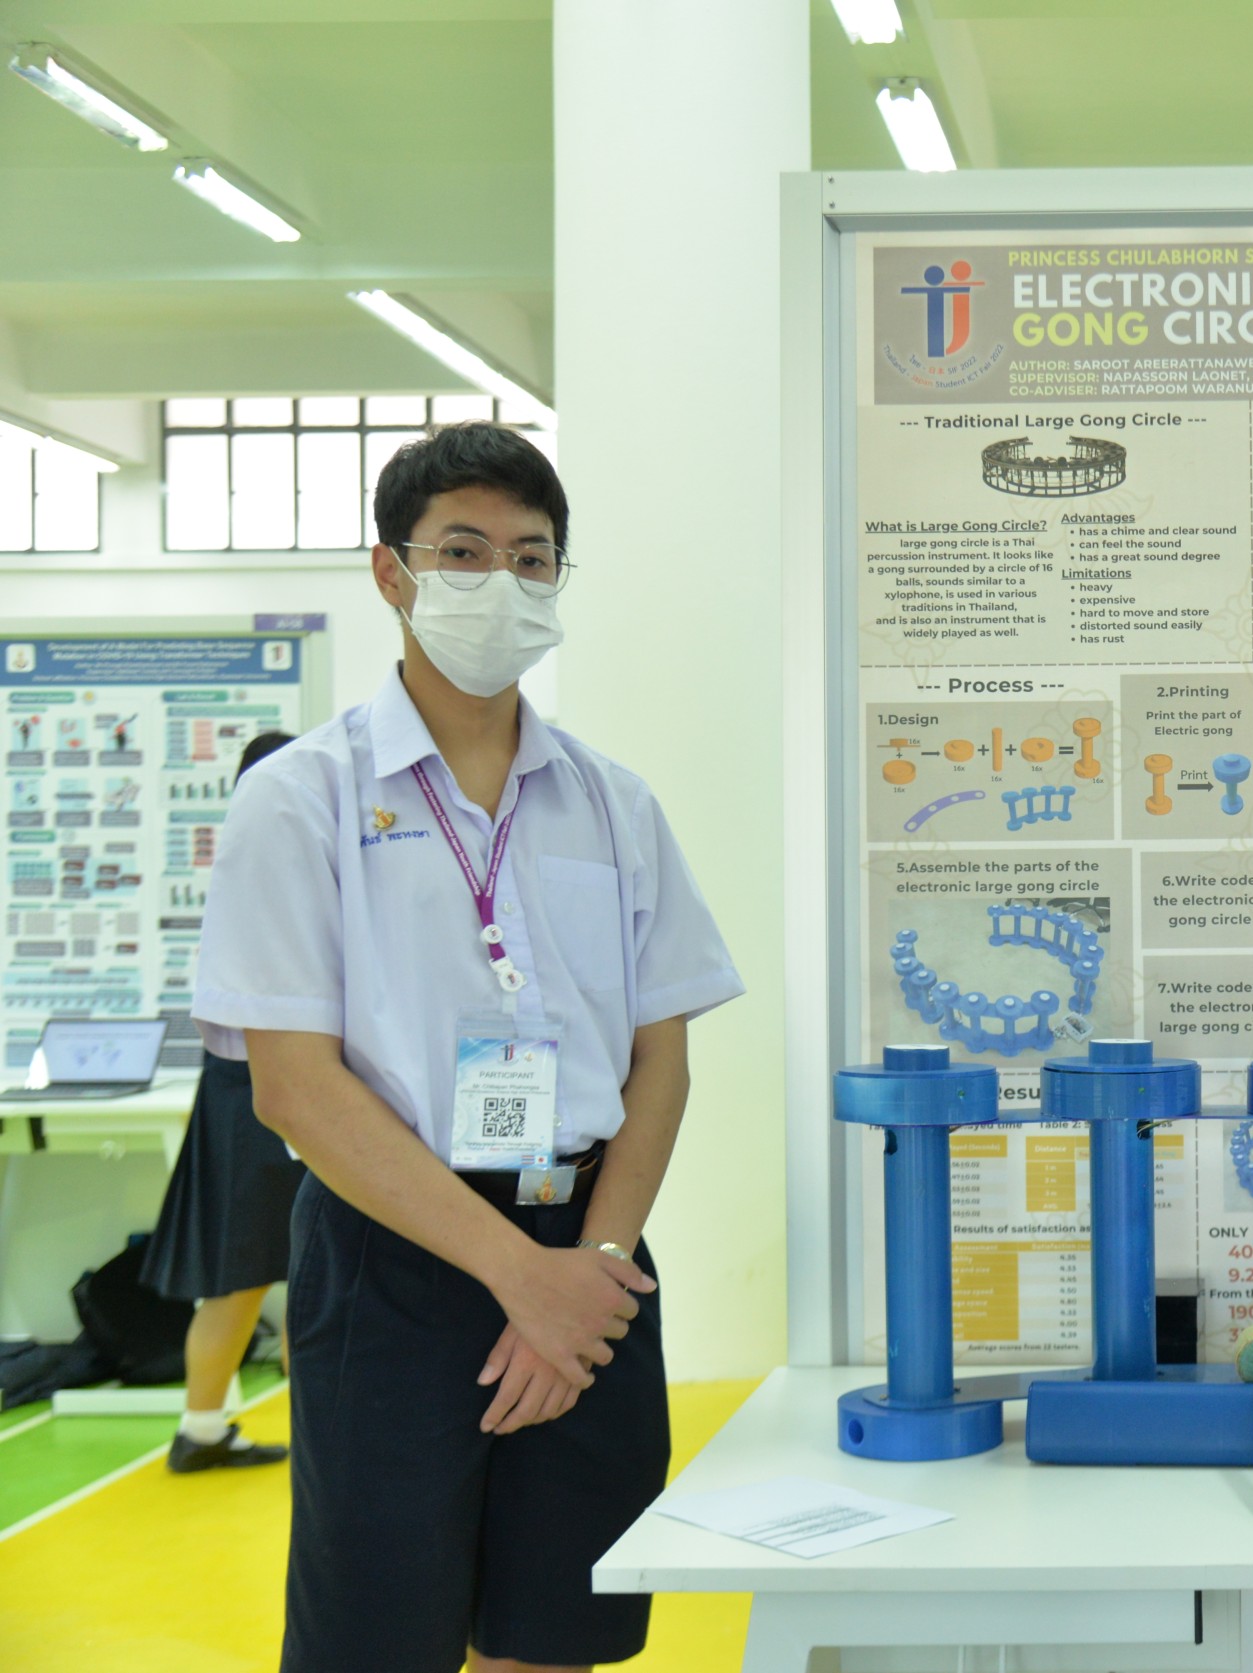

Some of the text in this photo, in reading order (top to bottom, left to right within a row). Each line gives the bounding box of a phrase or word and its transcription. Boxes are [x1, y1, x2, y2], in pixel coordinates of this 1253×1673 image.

[1008, 251, 1101, 267] PRINCESS
[1107, 249, 1238, 266] CHULABHORN
[1013, 311, 1149, 346] GONG
[936, 378, 966, 388] Student
[990, 343, 1004, 362] 2022
[960, 355, 976, 370] 2022
[1009, 360, 1069, 371] AUTHOR:
[1074, 359, 1130, 370] SAROOT
[1009, 373, 1099, 384] SUPERVISOR:
[1103, 372, 1188, 382] NAPASSORN
[1192, 370, 1250, 383] LAONET,
[1009, 385, 1098, 396] CO-ADVISER:
[1101, 384, 1188, 396] RATTAPOOM
[924, 412, 1181, 429] Traditional Large Gong Circle
[1061, 512, 1136, 522] Advantages
[865, 520, 1046, 531] What is Large Gong Circle?
[900, 539, 927, 549] large
[960, 538, 989, 546] circle
[992, 538, 1000, 546] is
[1012, 537, 1034, 546] Thai
[867, 552, 924, 562] percussion
[928, 551, 989, 559] instrument.
[1034, 550, 1053, 558] like
[1061, 568, 1133, 577] Limitations
[1080, 583, 1112, 592] heavy
[1079, 595, 1135, 605] expensive
[902, 603, 952, 611] traditions
[969, 602, 1016, 611] Thailand,
[1080, 620, 1202, 630] distorted sound easily
[949, 678, 1033, 692] Process
[1157, 686, 1228, 699] 2.Printing
[878, 714, 938, 727] 1.Design
[1154, 726, 1232, 736] Electric gong
[1181, 770, 1207, 779] Print
[897, 860, 1098, 873] 5.Assemble the parts of the
[1162, 874, 1216, 885] 6.Write
[897, 880, 1099, 893] electronic large gong circle
[1169, 916, 1206, 927] gong
[1211, 913, 1251, 924] circle
[1160, 1021, 1196, 1034] large
[1202, 1024, 1239, 1034] gong
[954, 1223, 1076, 1234] Results of satisfaction
[1209, 1228, 1248, 1238] ONLY
[1210, 1289, 1240, 1298] From
